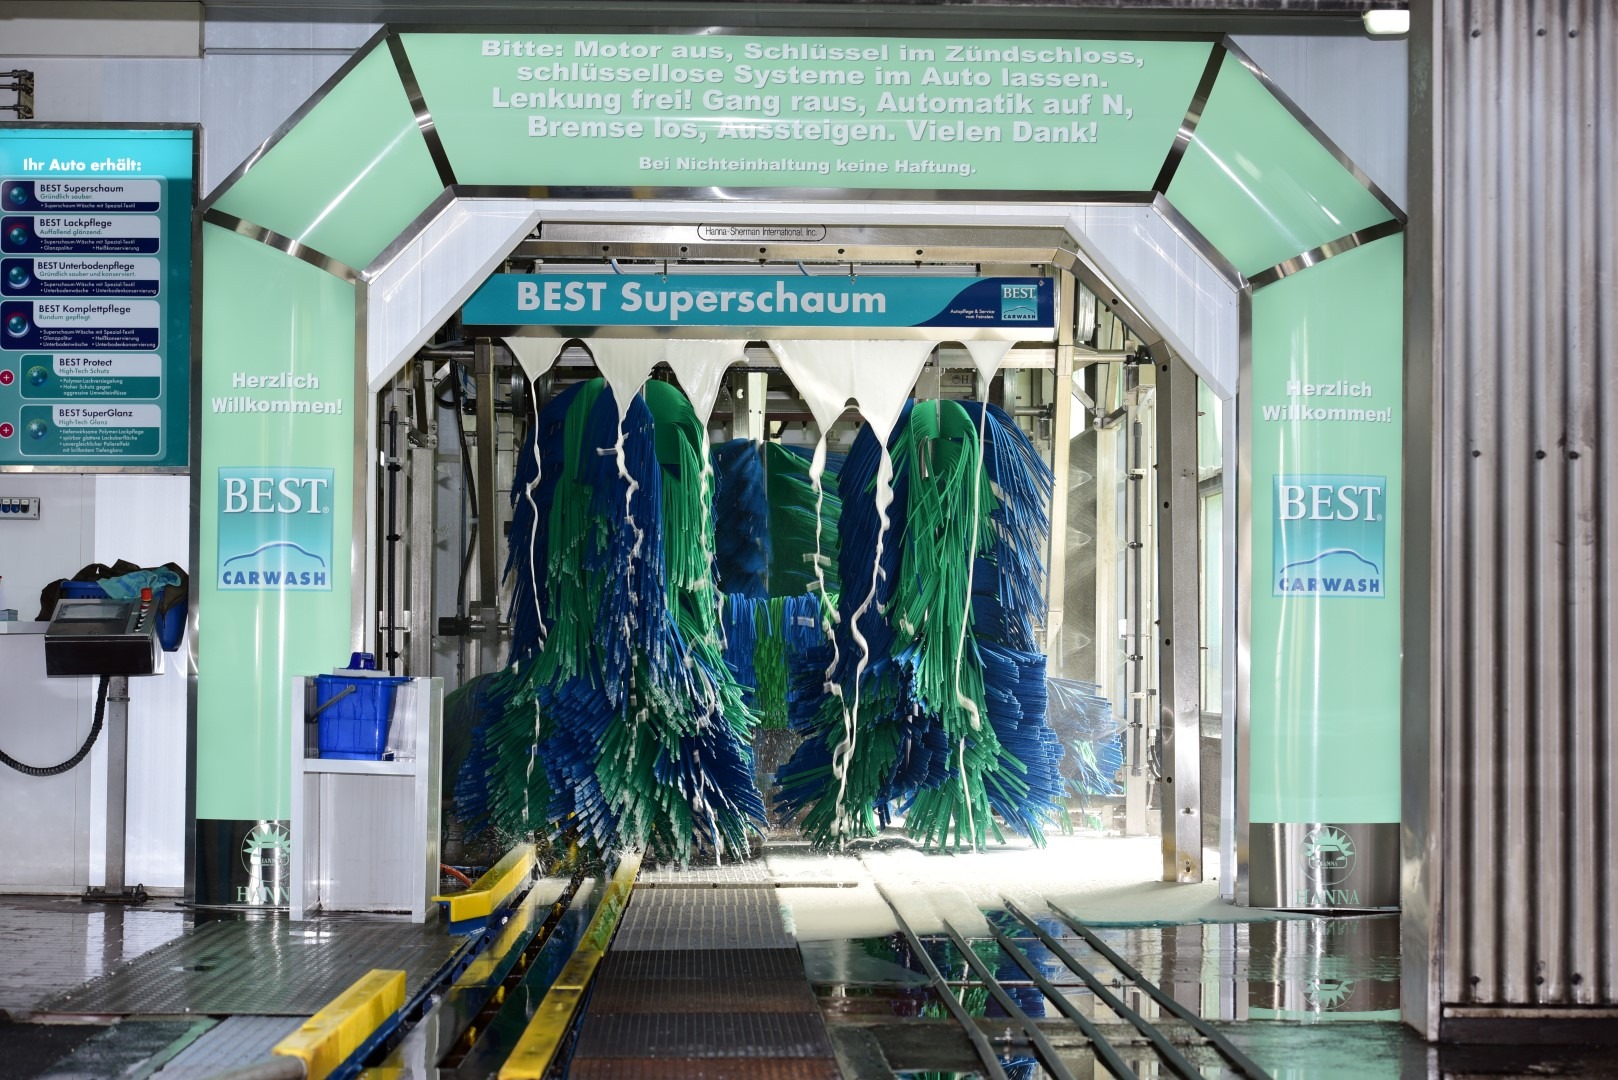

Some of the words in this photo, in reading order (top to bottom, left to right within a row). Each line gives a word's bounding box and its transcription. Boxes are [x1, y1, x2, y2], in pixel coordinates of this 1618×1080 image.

[481, 39, 564, 58] Bitte:
[574, 40, 663, 59] Motor
[671, 42, 734, 63] aus,
[744, 42, 889, 62] Schlüssel
[900, 44, 935, 62] im
[945, 45, 1145, 68] Zündschloss,
[517, 62, 724, 84] schlüssellose
[734, 64, 865, 88] Systeme
[875, 66, 911, 86] im
[921, 66, 992, 87] Auto
[1001, 67, 1109, 88] lassen.
[492, 86, 622, 115] Lenkung
[631, 88, 692, 110] frei!
[702, 89, 781, 117] Gang
[791, 93, 867, 117] raus,
[876, 91, 1034, 115] Automatik
[1043, 93, 1092, 115] auf
[1102, 94, 1134, 120] N,
[528, 115, 644, 138] Bremse
[654, 116, 707, 143] los,
[716, 118, 897, 146] Aussteigen.
[907, 120, 1002, 142] Vielen
[1013, 120, 1098, 143] Dank!
[23, 158, 45, 171] Ihr
[49, 158, 86, 171] Auto
[90, 157, 142, 171] erhält:
[639, 156, 670, 170] Bei
[676, 156, 830, 175] Nichteinhaltung
[836, 159, 889, 173] keine
[895, 159, 977, 177] Haftung.
[40, 184, 61, 192] BEST
[64, 184, 124, 194] Superschaum
[40, 218, 61, 227] BEST
[64, 218, 112, 229] Lackpflege
[705, 226, 760, 236] Hanna-Sherman
[806, 227, 818, 237] Inc.
[37, 261, 58, 270] BEST
[59, 261, 135, 272] Unterbodenpflege
[516, 281, 608, 311] BEST
[620, 280, 886, 321] Superschaum
[1003, 287, 1036, 299] BEST
[38, 304, 60, 313] BEST
[62, 304, 131, 315] Komplettpflege
[59, 358, 81, 367] BEST
[83, 358, 113, 367] Protect
[232, 372, 320, 390] Herzlich
[1286, 380, 1372, 397] Herzlich
[59, 408, 81, 417] BEST
[82, 408, 133, 419] SuperGlanz
[211, 397, 343, 415] Willkommen!
[1262, 405, 1392, 423] Willkommen!
[223, 477, 328, 514] BEST
[1279, 485, 1381, 521] BEST
[222, 571, 326, 586] CARWASH
[1279, 577, 1380, 593] CARWASH
[236, 886, 290, 902] HANN
[1295, 889, 1361, 905] HANNA
